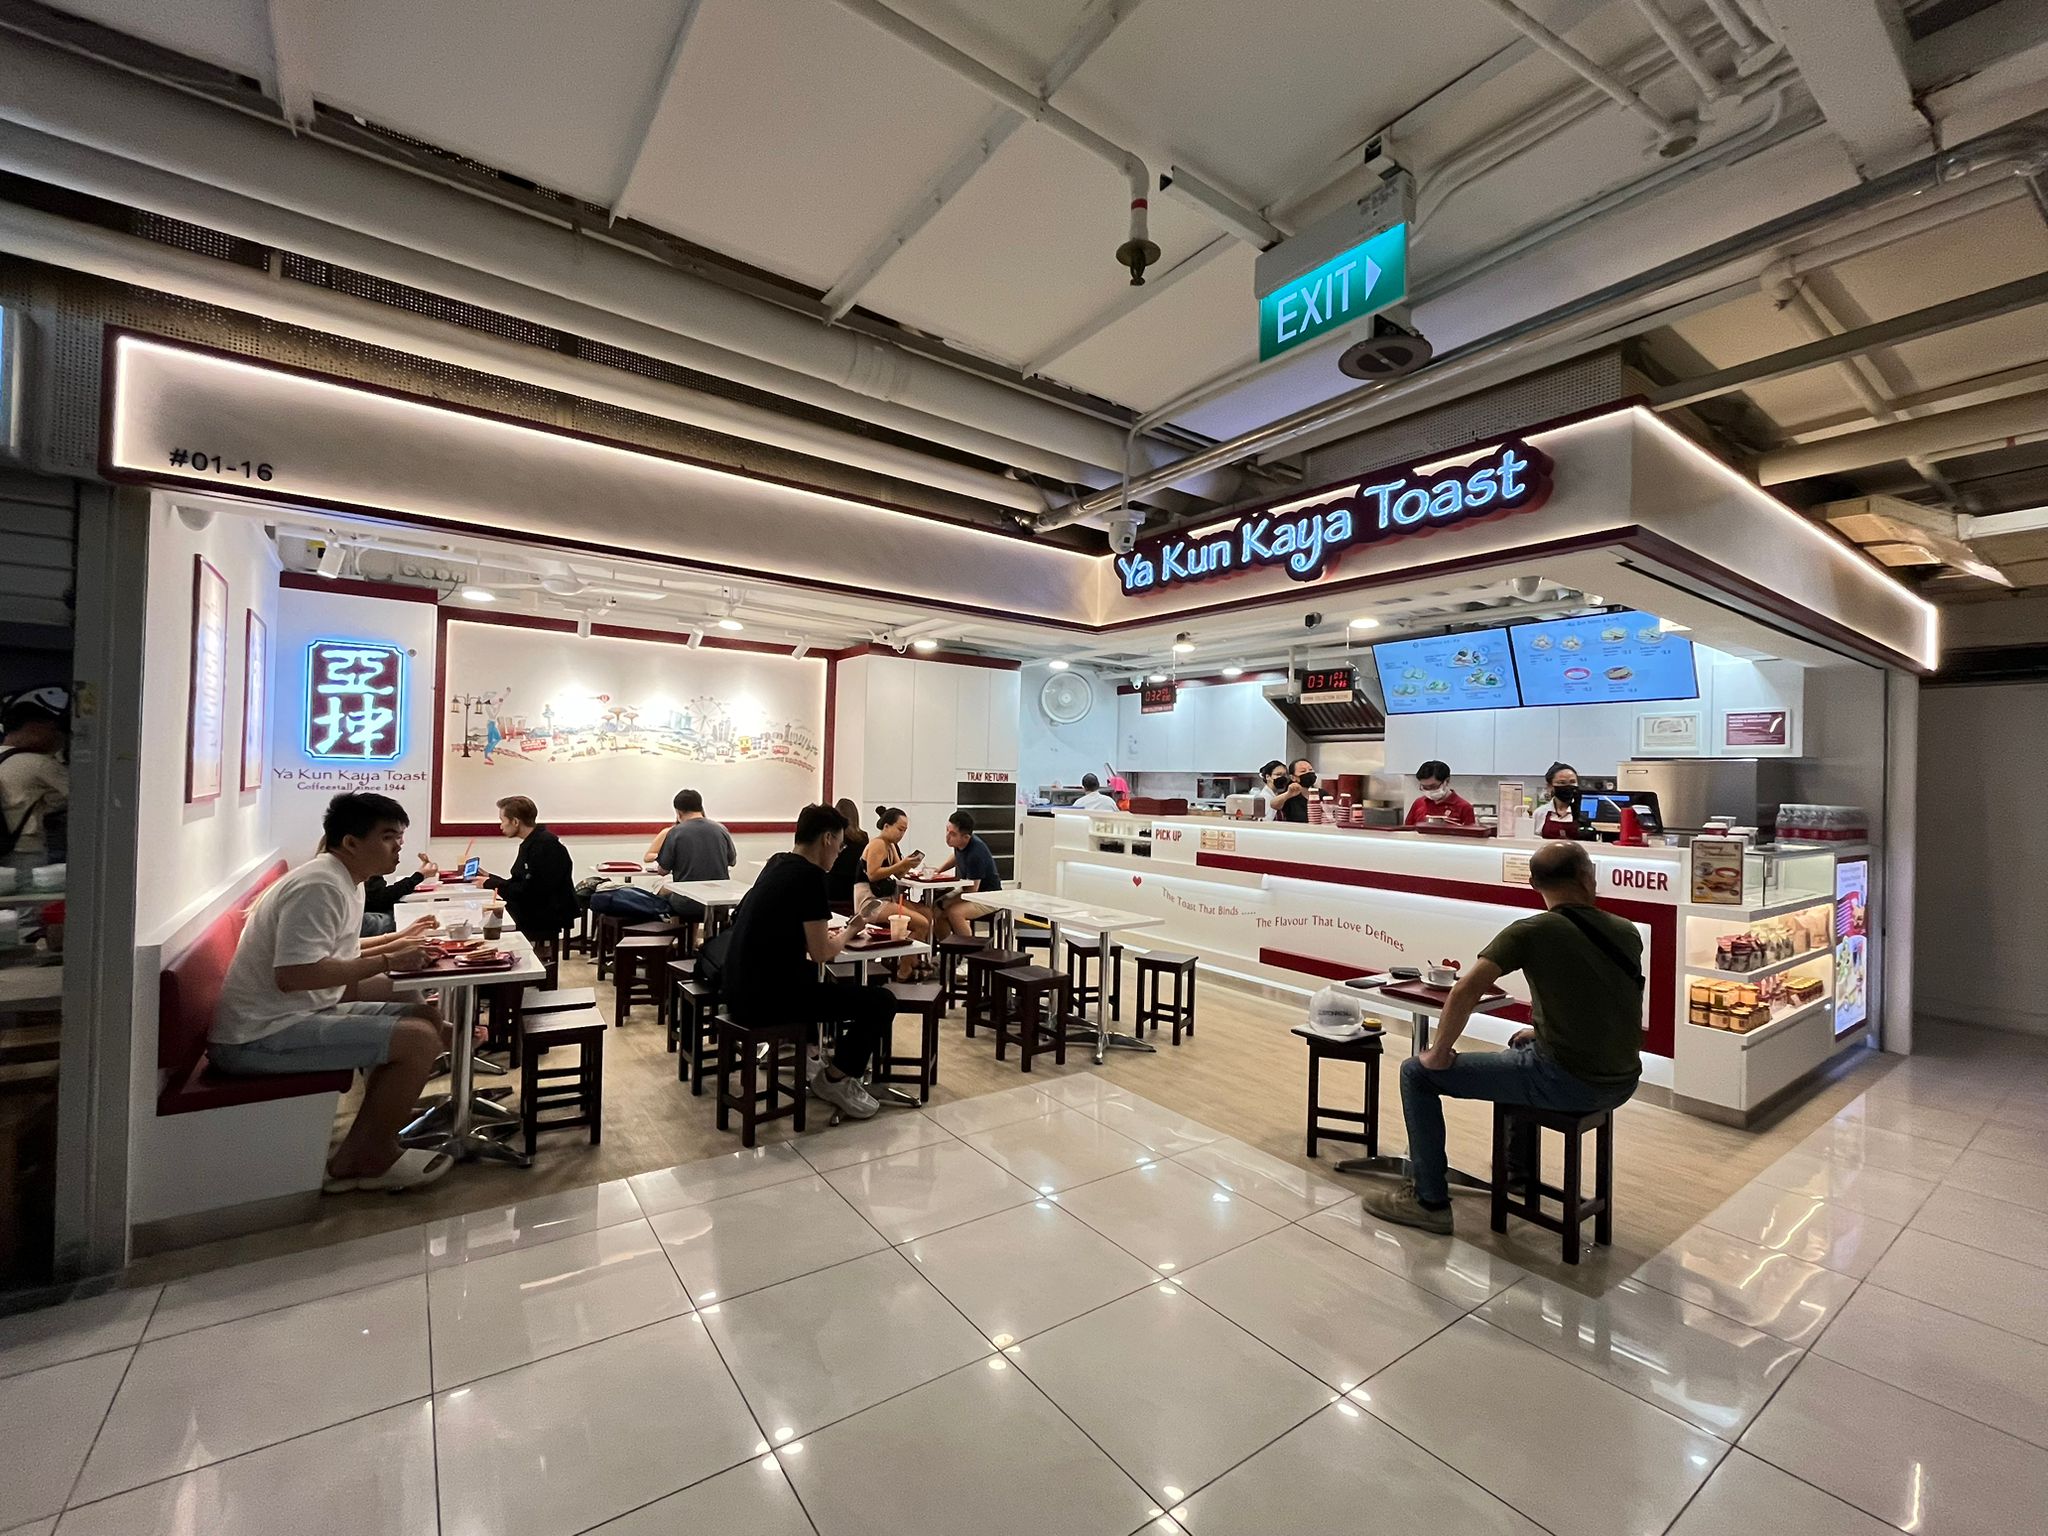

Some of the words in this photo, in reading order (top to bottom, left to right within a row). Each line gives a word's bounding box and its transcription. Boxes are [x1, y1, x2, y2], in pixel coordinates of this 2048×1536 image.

[1277, 261, 1358, 344] EXIT
[168, 447, 274, 482] #01-16
[1117, 551, 1154, 590] Ya
[1161, 537, 1231, 582] Kun
[1242, 507, 1353, 573] Kaya
[1363, 448, 1529, 530] Toast
[1307, 674, 1333, 689] 031
[1144, 690, 1162, 703] 032
[273, 768, 293, 780] Ya
[298, 768, 332, 781] Kun
[338, 769, 380, 786] Kaya
[384, 769, 427, 781] Toast
[384, 783, 405, 791] 1944
[967, 772, 983, 781] TRAY
[984, 772, 1009, 782] RETURN
[1155, 828, 1171, 840] PICK
[1172, 830, 1182, 842] UP
[1612, 868, 1668, 892] ORDER
[1162, 887, 1175, 903] The
[1178, 896, 1196, 912] Toast
[1199, 903, 1215, 915] That
[1218, 905, 1239, 916] Binds
[1256, 918, 1272, 928] The
[1275, 916, 1308, 928] Flavour
[1312, 915, 1333, 928] That
[1338, 917, 1362, 933] Love
[1365, 923, 1405, 952] Defines
